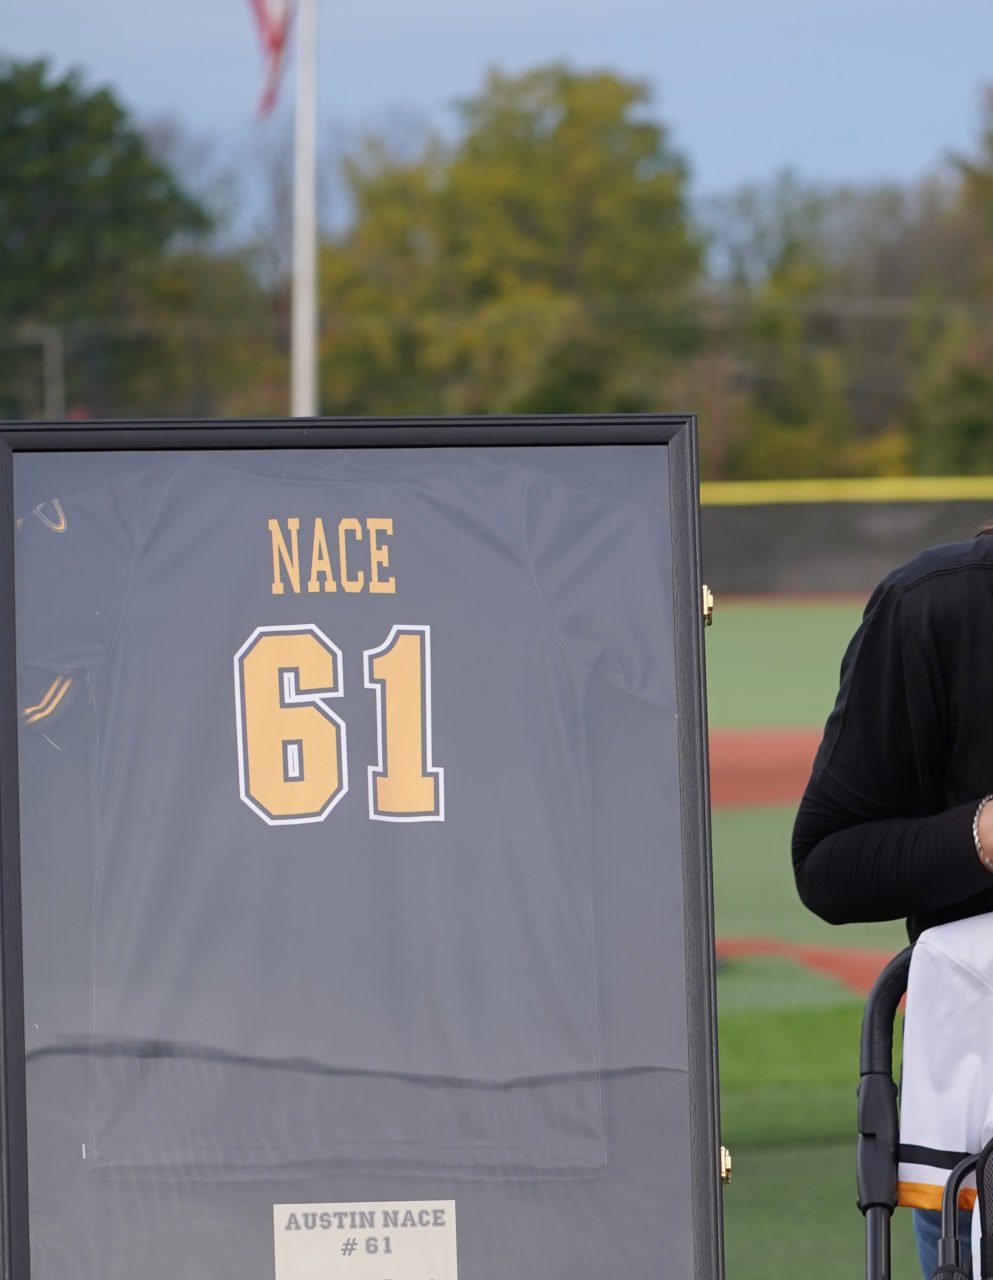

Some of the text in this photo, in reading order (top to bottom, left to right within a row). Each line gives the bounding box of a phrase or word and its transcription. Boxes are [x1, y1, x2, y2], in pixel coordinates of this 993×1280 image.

[268, 517, 396, 594] NACE
[233, 623, 445, 826] 61
[285, 1209, 446, 1231] AUSTIN NACE
